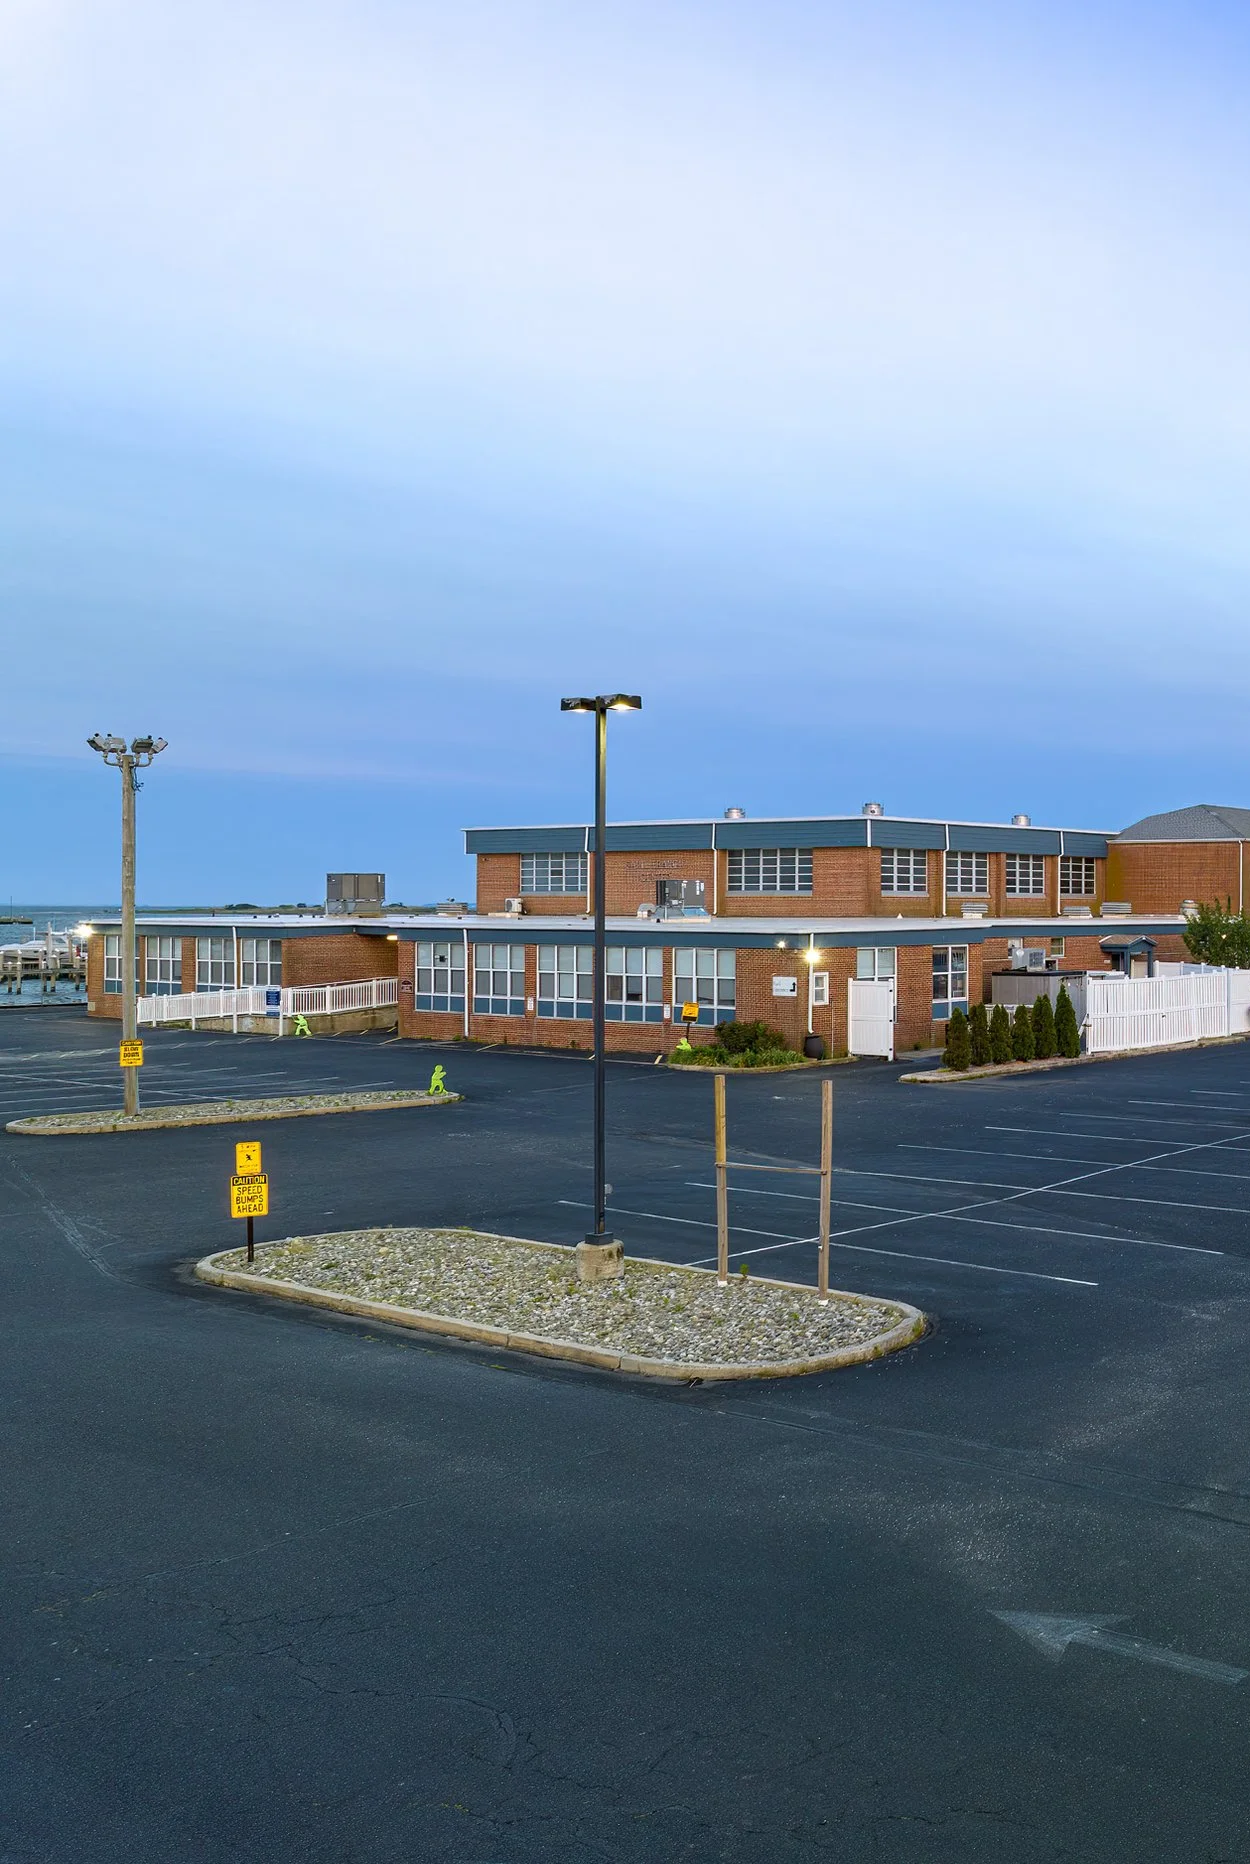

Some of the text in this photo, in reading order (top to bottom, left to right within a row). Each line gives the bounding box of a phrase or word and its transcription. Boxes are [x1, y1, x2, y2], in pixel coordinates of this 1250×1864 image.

[233, 1175, 265, 1186] CAUTION
[236, 1186, 263, 1196] SPEED
[235, 1195, 263, 1205] BUMPS
[236, 1204, 263, 1214] AHEAD
